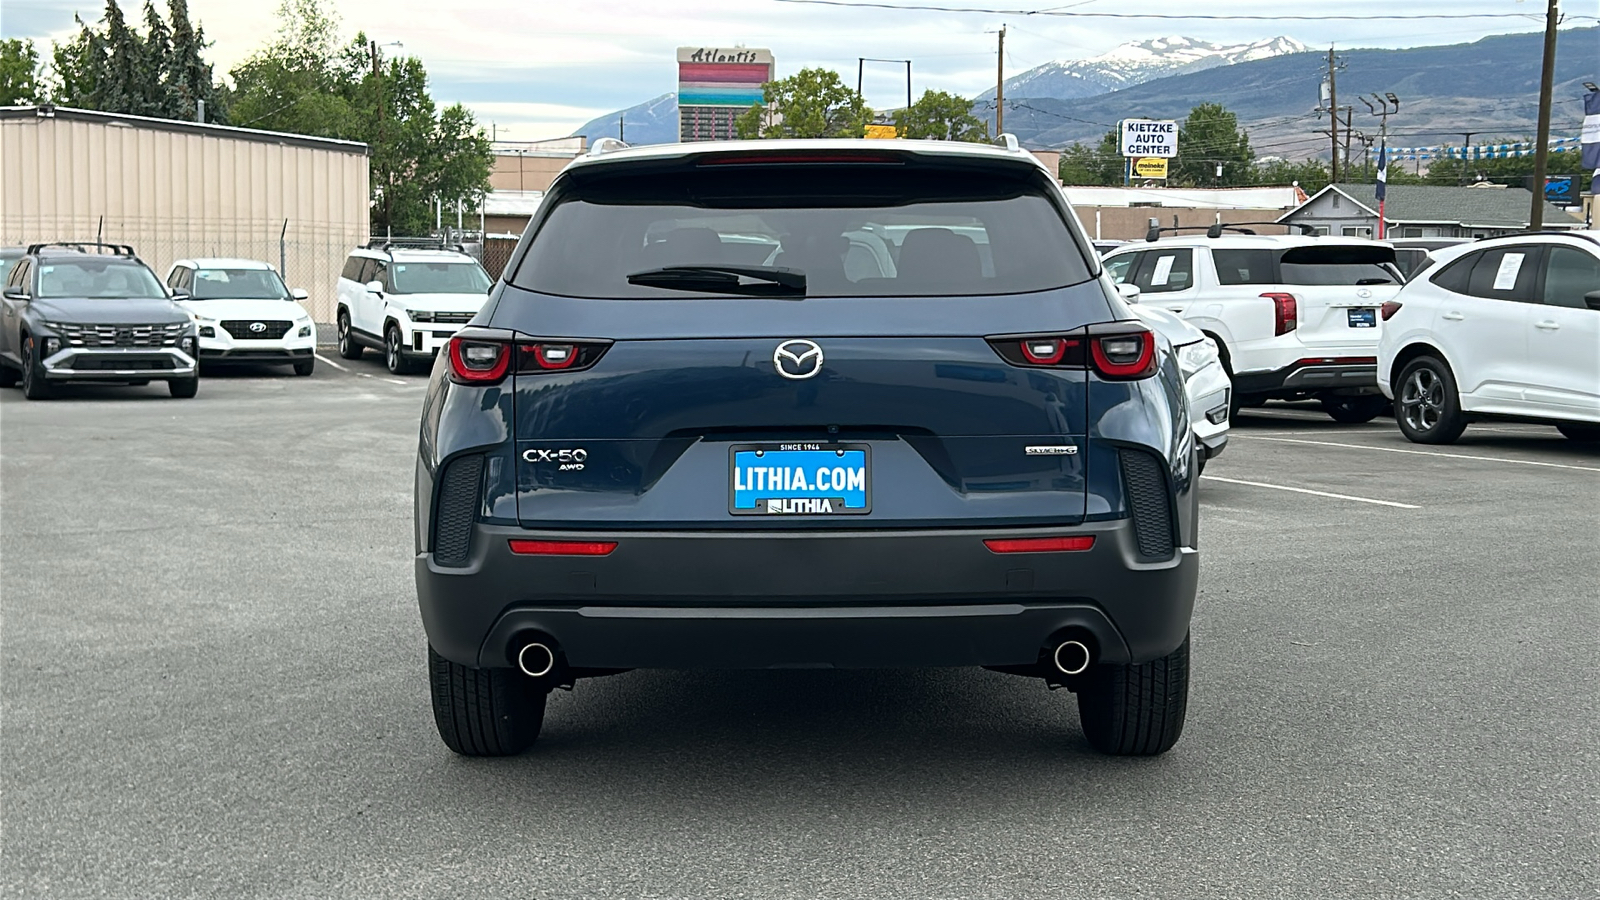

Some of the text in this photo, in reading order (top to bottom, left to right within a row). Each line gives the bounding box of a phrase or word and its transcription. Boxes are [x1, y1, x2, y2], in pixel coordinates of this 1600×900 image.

[691, 48, 756, 62] Atlantis
[1128, 122, 1173, 133] KIETZKE
[1135, 134, 1164, 143] AUTO
[1128, 144, 1170, 154] CENTER
[522, 448, 588, 462] CX-50
[558, 463, 585, 471] AWD
[734, 466, 865, 492] LITHIA.COM
[782, 498, 832, 513] LITHIA
